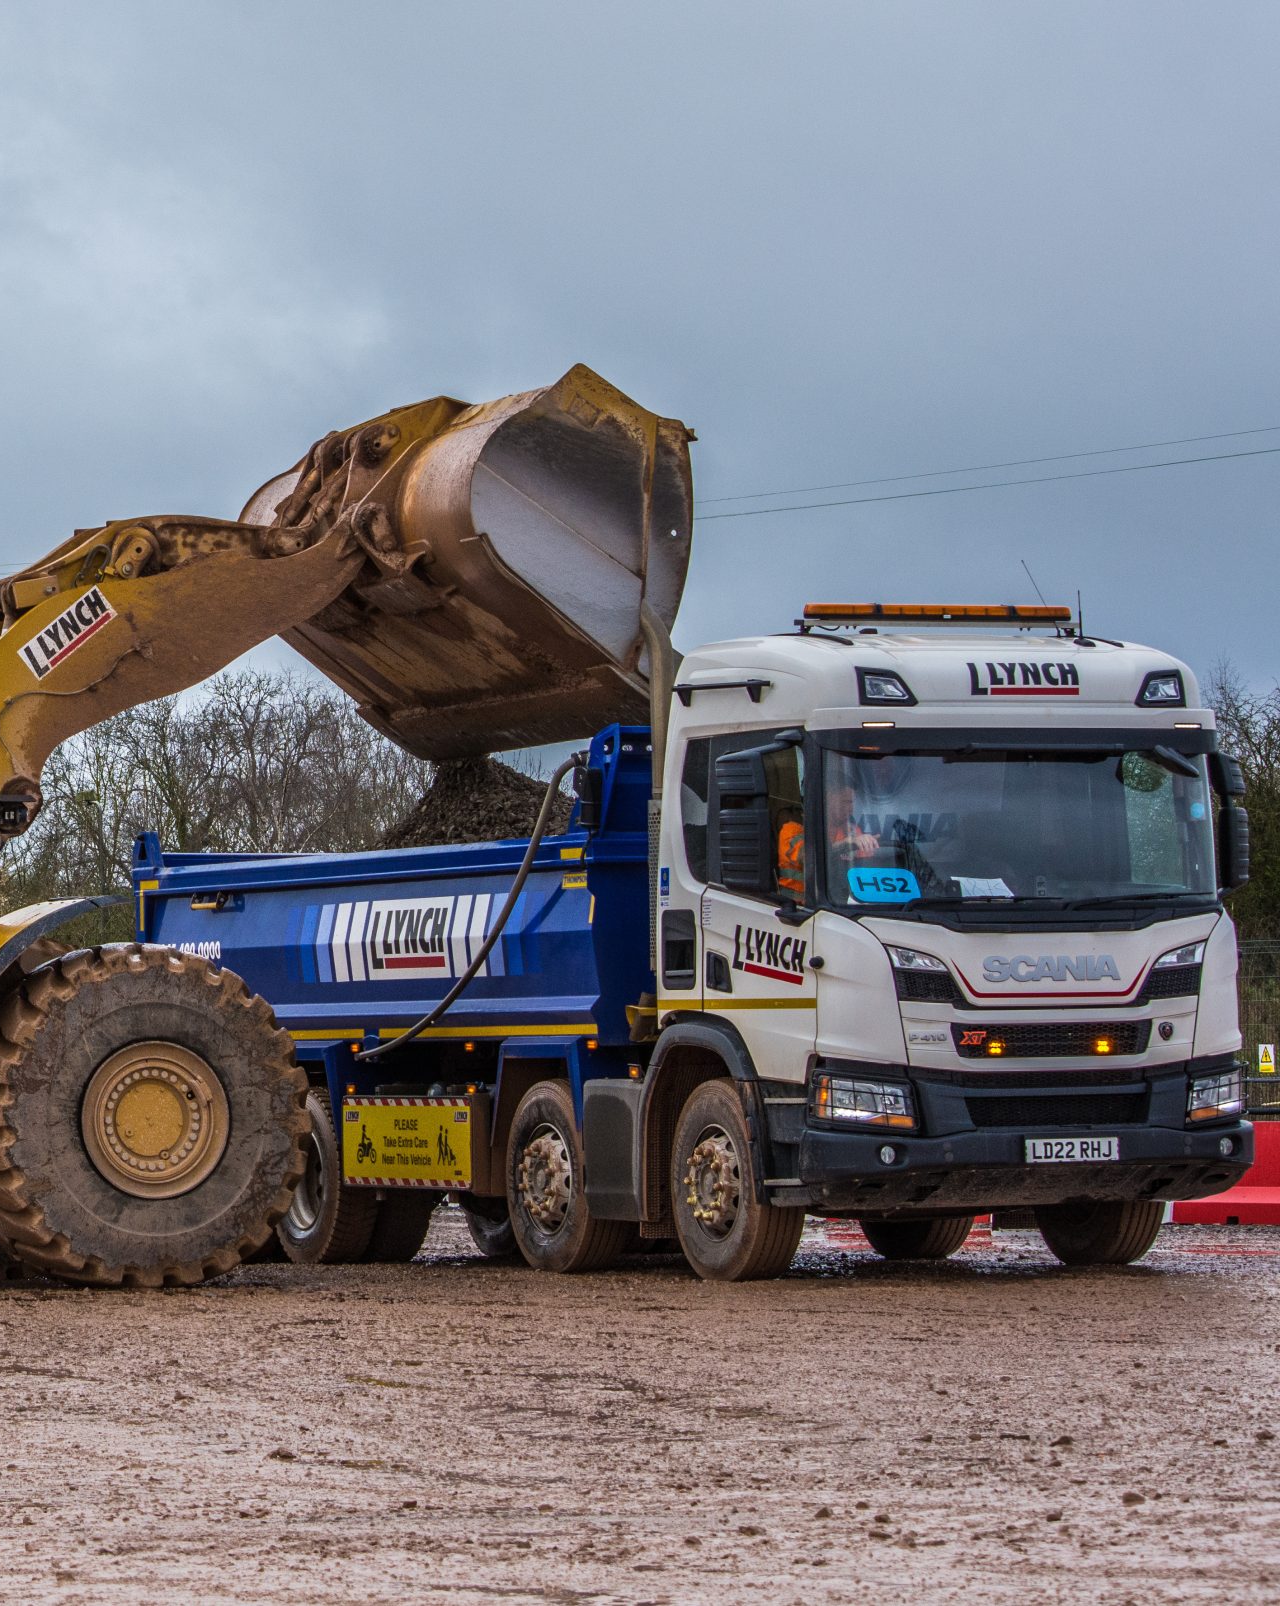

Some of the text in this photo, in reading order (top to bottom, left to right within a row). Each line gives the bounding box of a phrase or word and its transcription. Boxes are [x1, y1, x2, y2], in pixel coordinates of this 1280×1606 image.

[856, 876, 912, 893] HS2
[982, 954, 1121, 983] SCANIA
[959, 1031, 987, 1045] XT
[394, 1119, 418, 1131] PLEASE
[383, 1136, 428, 1149] Take Extra Care
[1032, 1140, 1113, 1160] LD22 RHJ
[382, 1153, 432, 1166] Near This Vehicle
